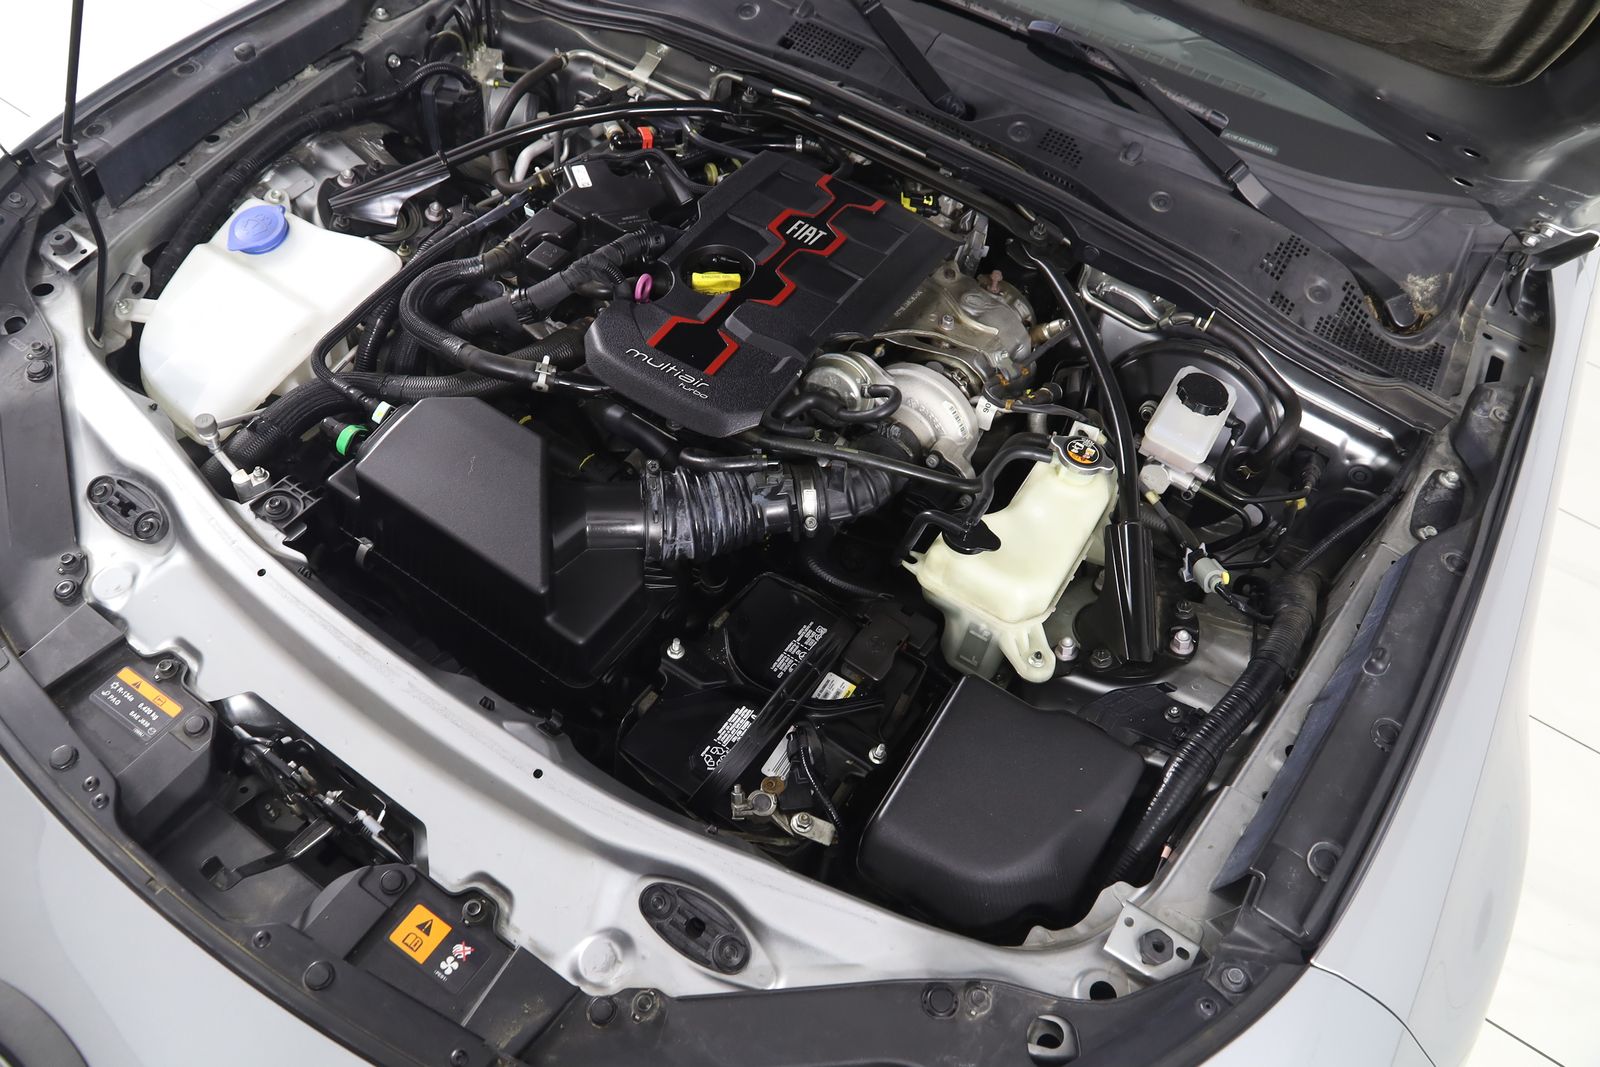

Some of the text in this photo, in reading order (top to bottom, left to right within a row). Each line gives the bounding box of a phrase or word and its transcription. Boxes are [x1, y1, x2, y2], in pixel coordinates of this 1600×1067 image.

[785, 219, 828, 246] FIAT
[625, 348, 710, 388] multiair
[678, 382, 709, 399] turbo
[117, 687, 135, 702] R-134a
[150, 712, 159, 721] kg
